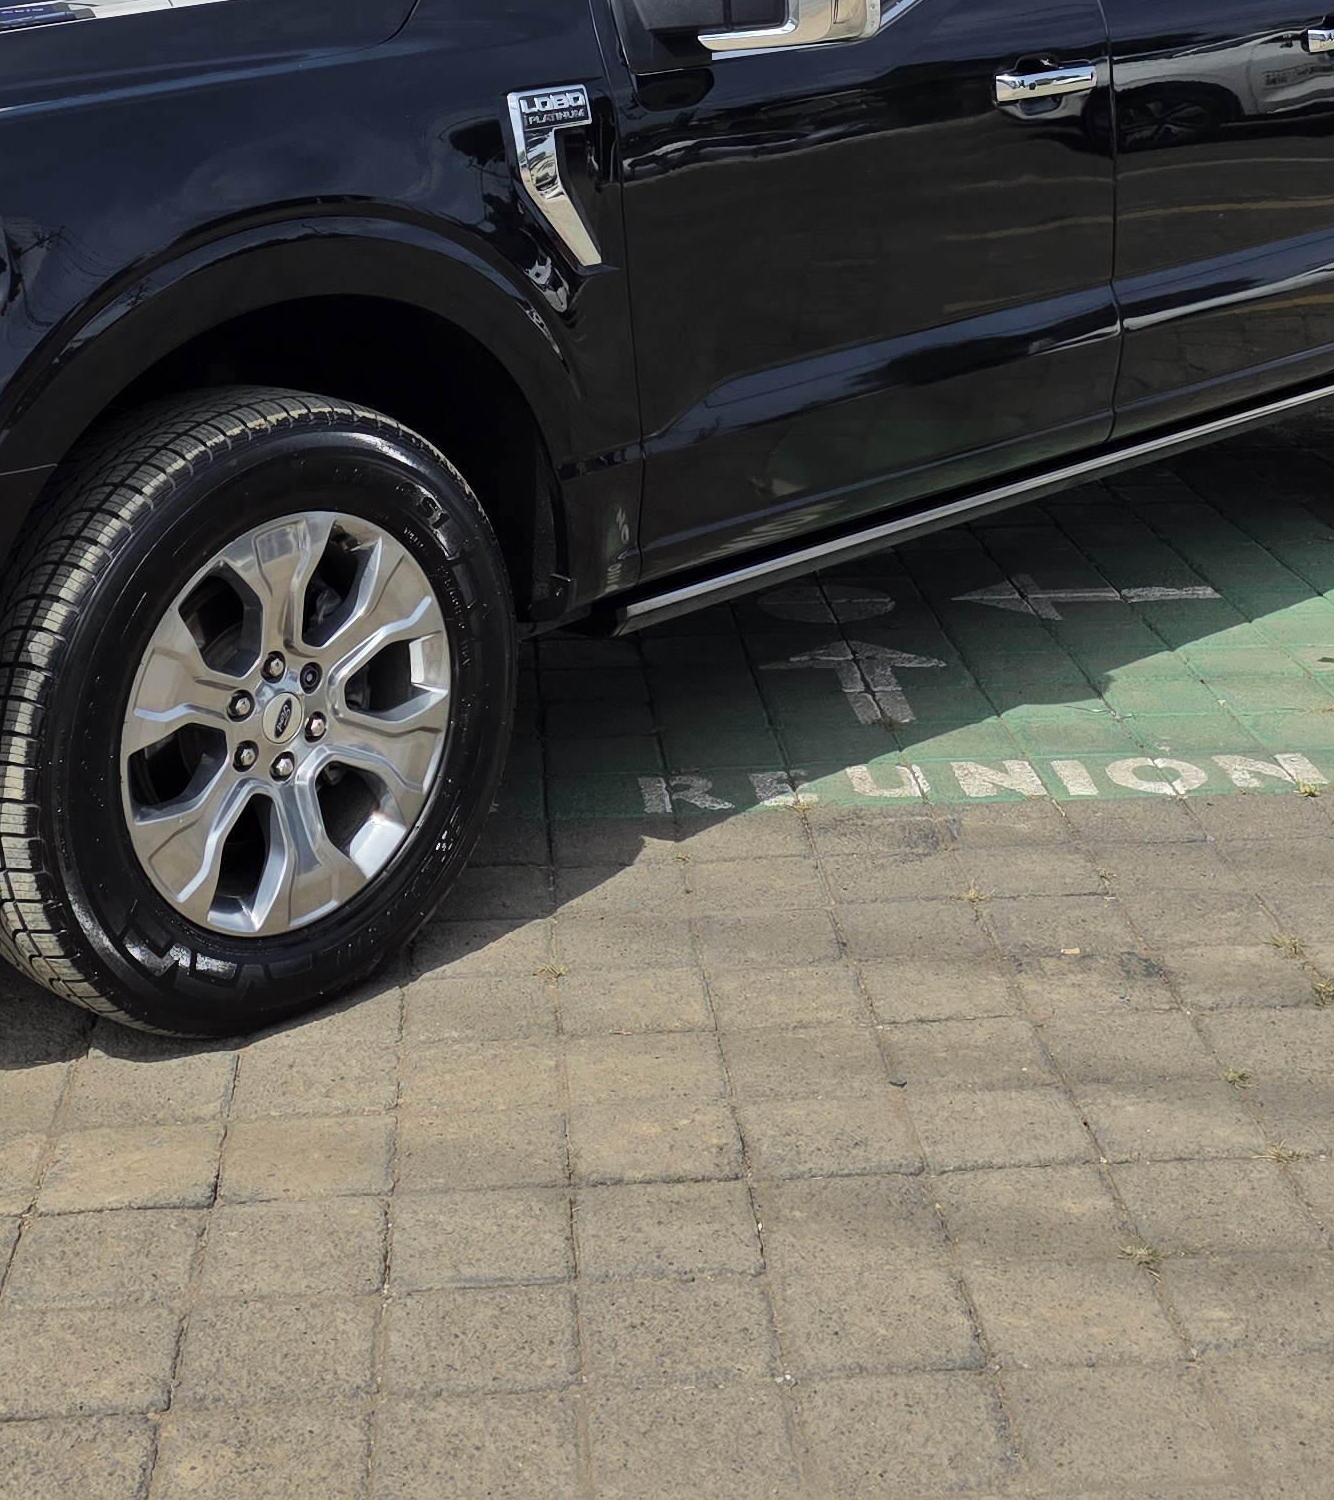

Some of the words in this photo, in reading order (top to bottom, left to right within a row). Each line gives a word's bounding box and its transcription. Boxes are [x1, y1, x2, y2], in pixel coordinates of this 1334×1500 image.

[520, 92, 585, 114] LOBO
[276, 704, 290, 732] Ford
[636, 752, 1331, 816] REUNION
